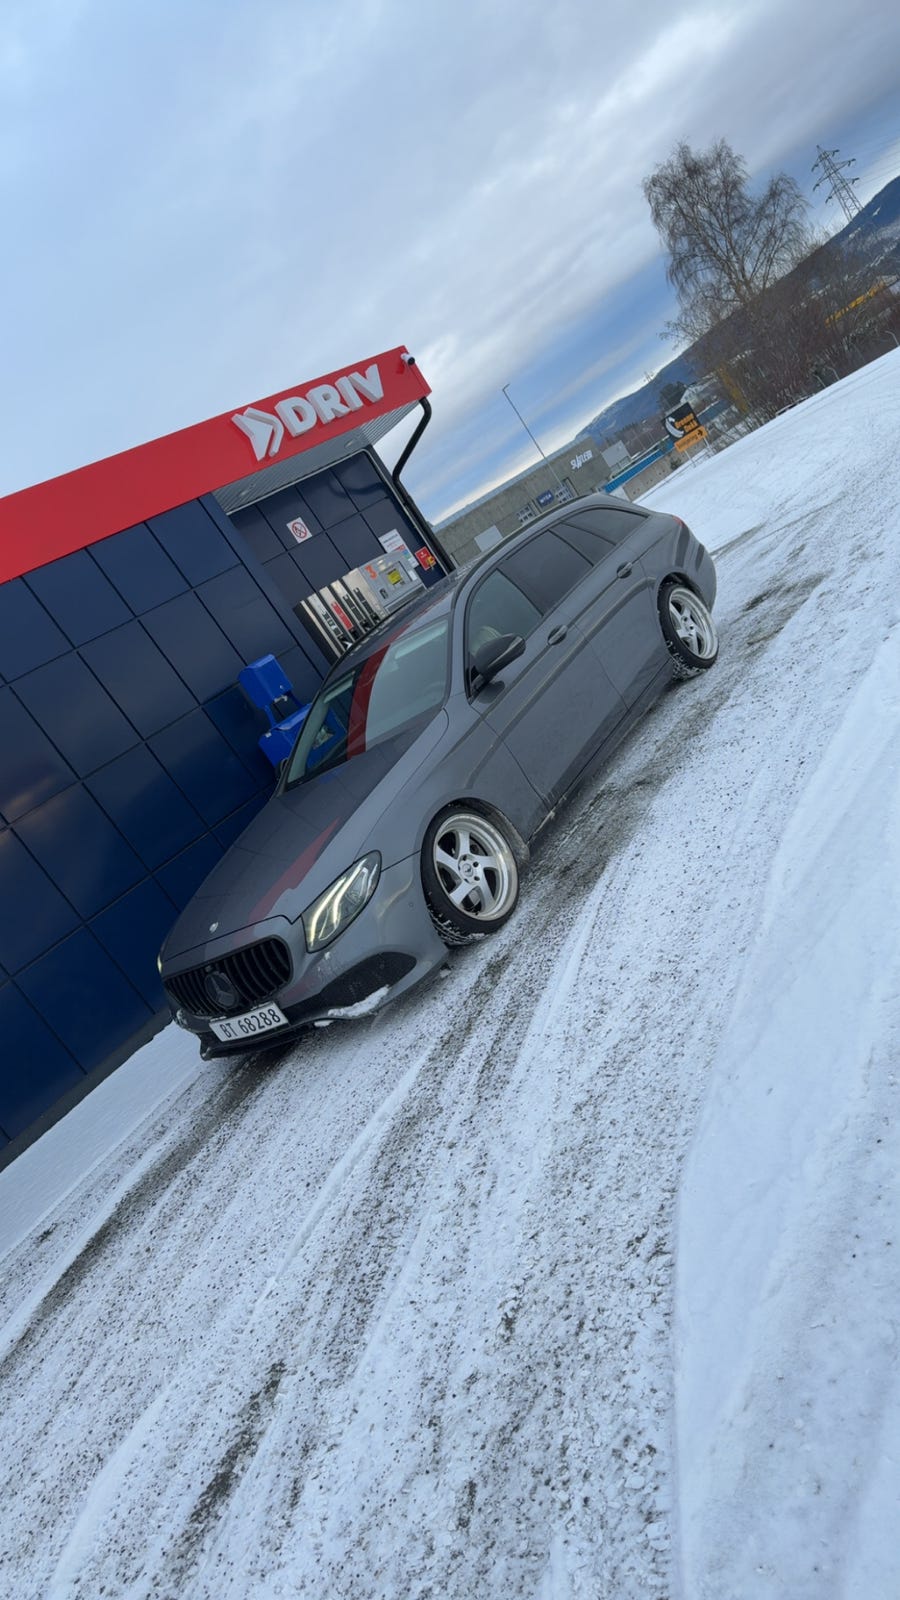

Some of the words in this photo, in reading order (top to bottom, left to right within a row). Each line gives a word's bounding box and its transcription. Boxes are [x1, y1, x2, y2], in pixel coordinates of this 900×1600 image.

[274, 364, 384, 437] DRIV
[220, 1023, 238, 1038] BT
[238, 1009, 281, 1034] 68288
